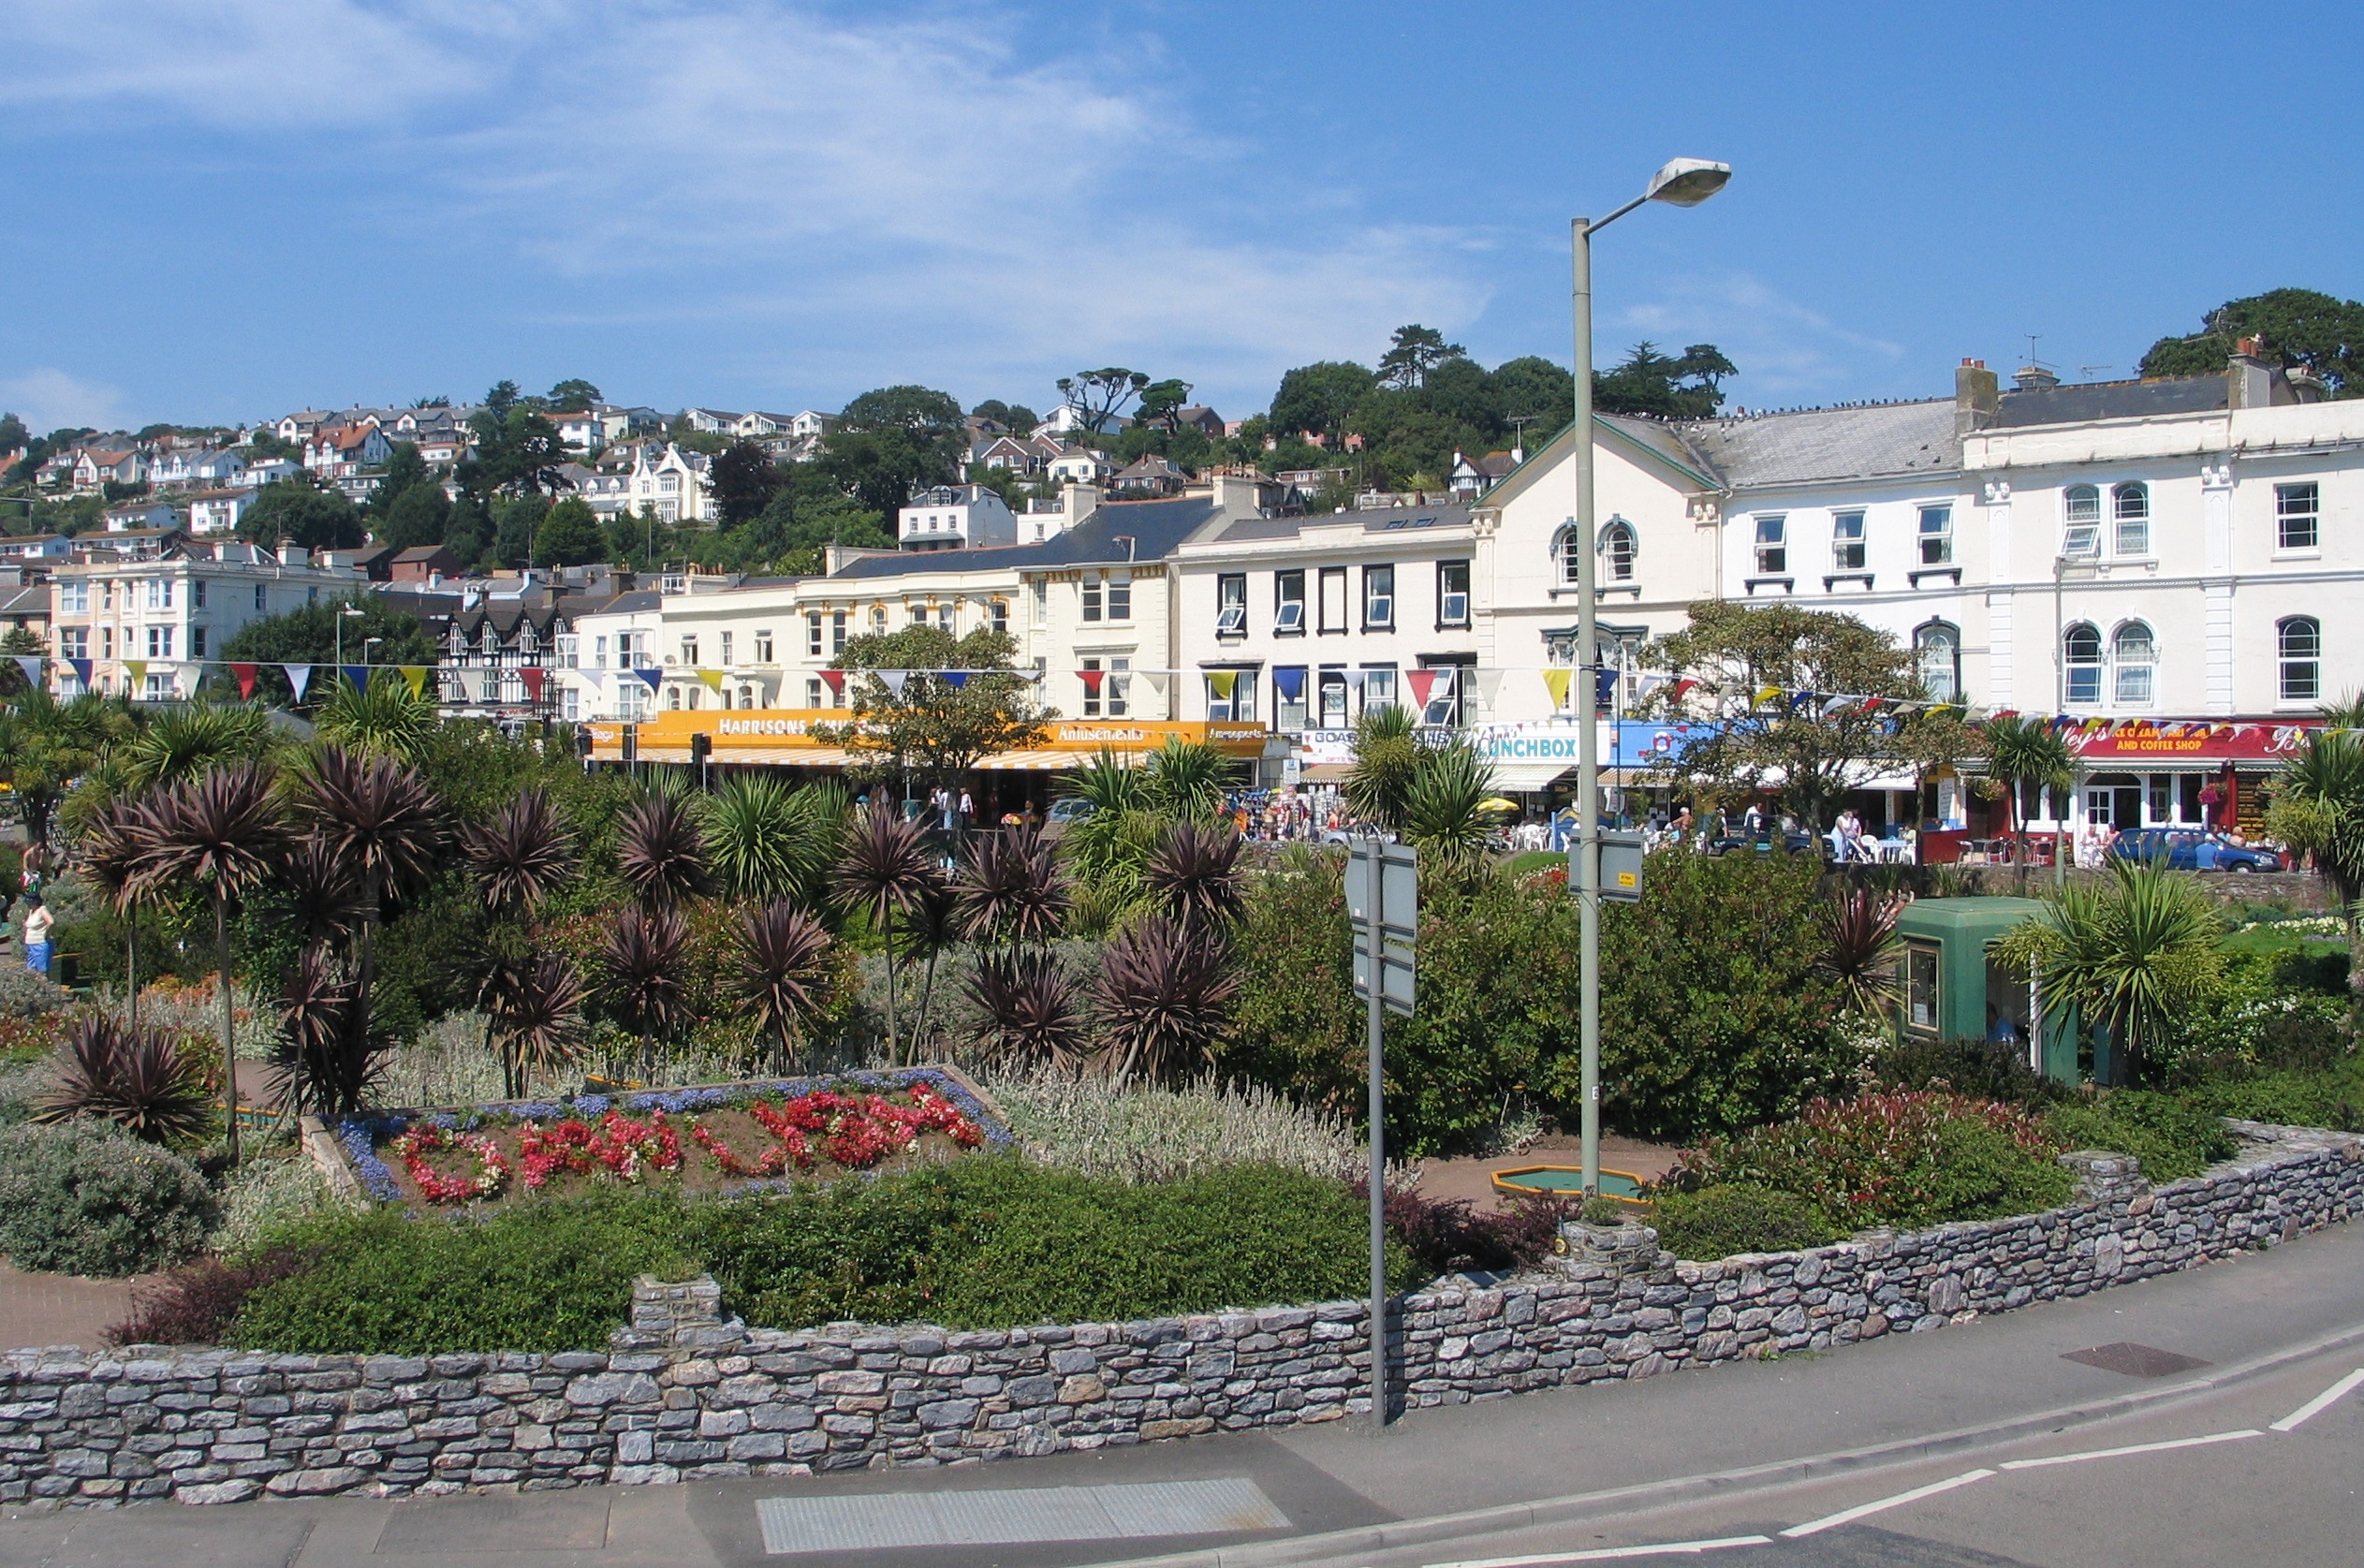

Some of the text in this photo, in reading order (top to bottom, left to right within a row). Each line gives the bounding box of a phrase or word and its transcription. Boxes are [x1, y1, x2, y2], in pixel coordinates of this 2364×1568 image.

[719, 718, 806, 735] HARRISONS
[1058, 726, 1144, 741] Amusements
[1477, 739, 1577, 757] LUNCHBOX
[2116, 740, 2202, 750] AND COFFEE SHOP
